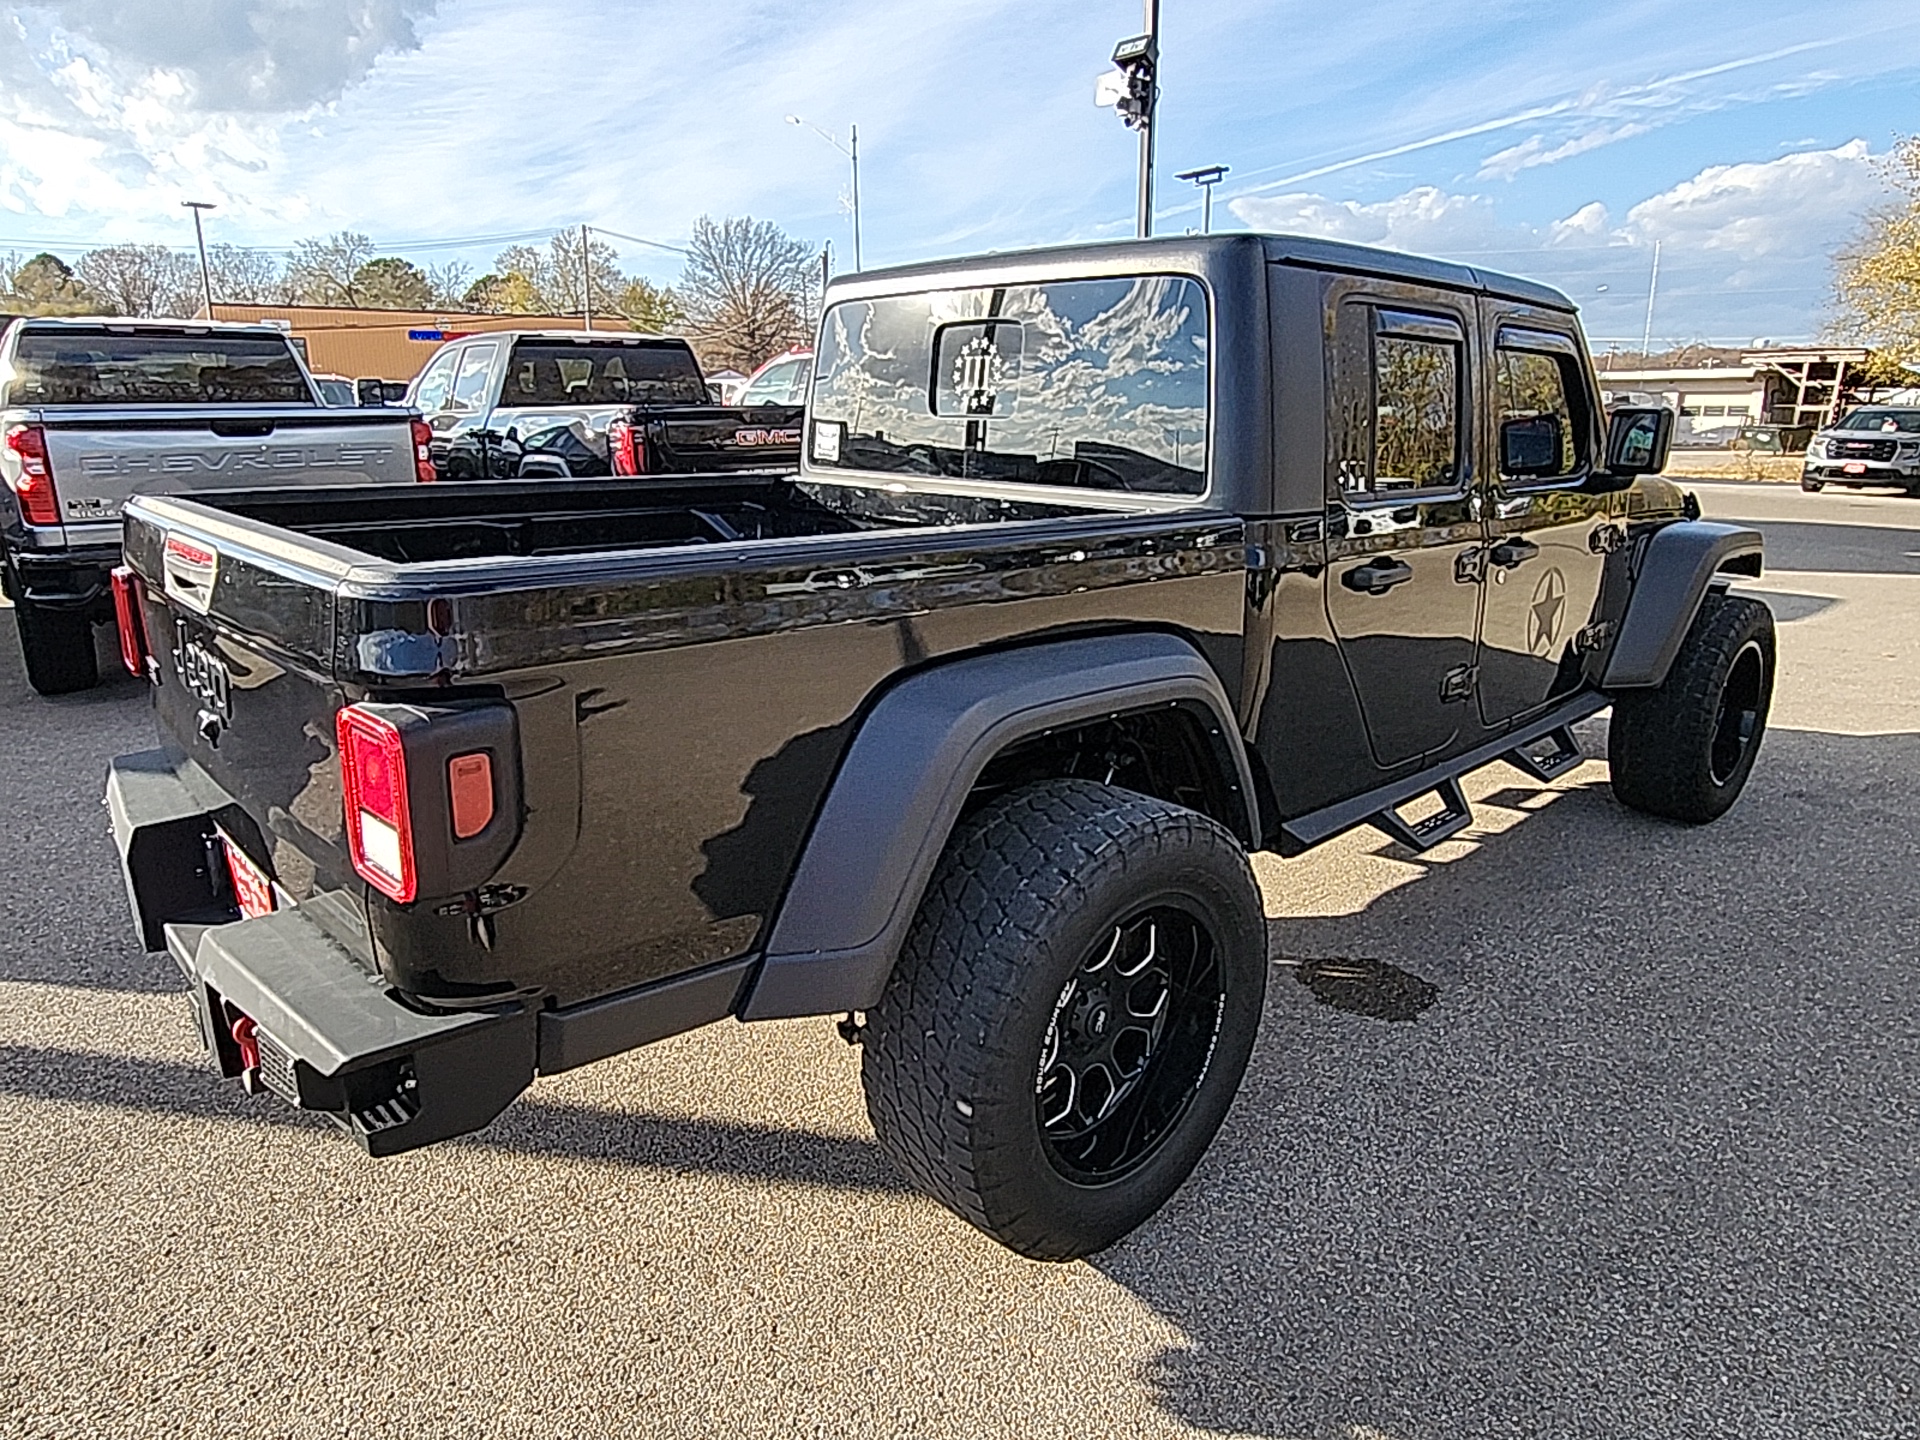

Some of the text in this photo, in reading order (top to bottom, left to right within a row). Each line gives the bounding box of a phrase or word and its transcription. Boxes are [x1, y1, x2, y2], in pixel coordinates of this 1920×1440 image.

[735, 429, 801, 446] GMC
[79, 443, 394, 476] CHEVROLET
[1035, 981, 1070, 1094] ROUGH COUNTRY
